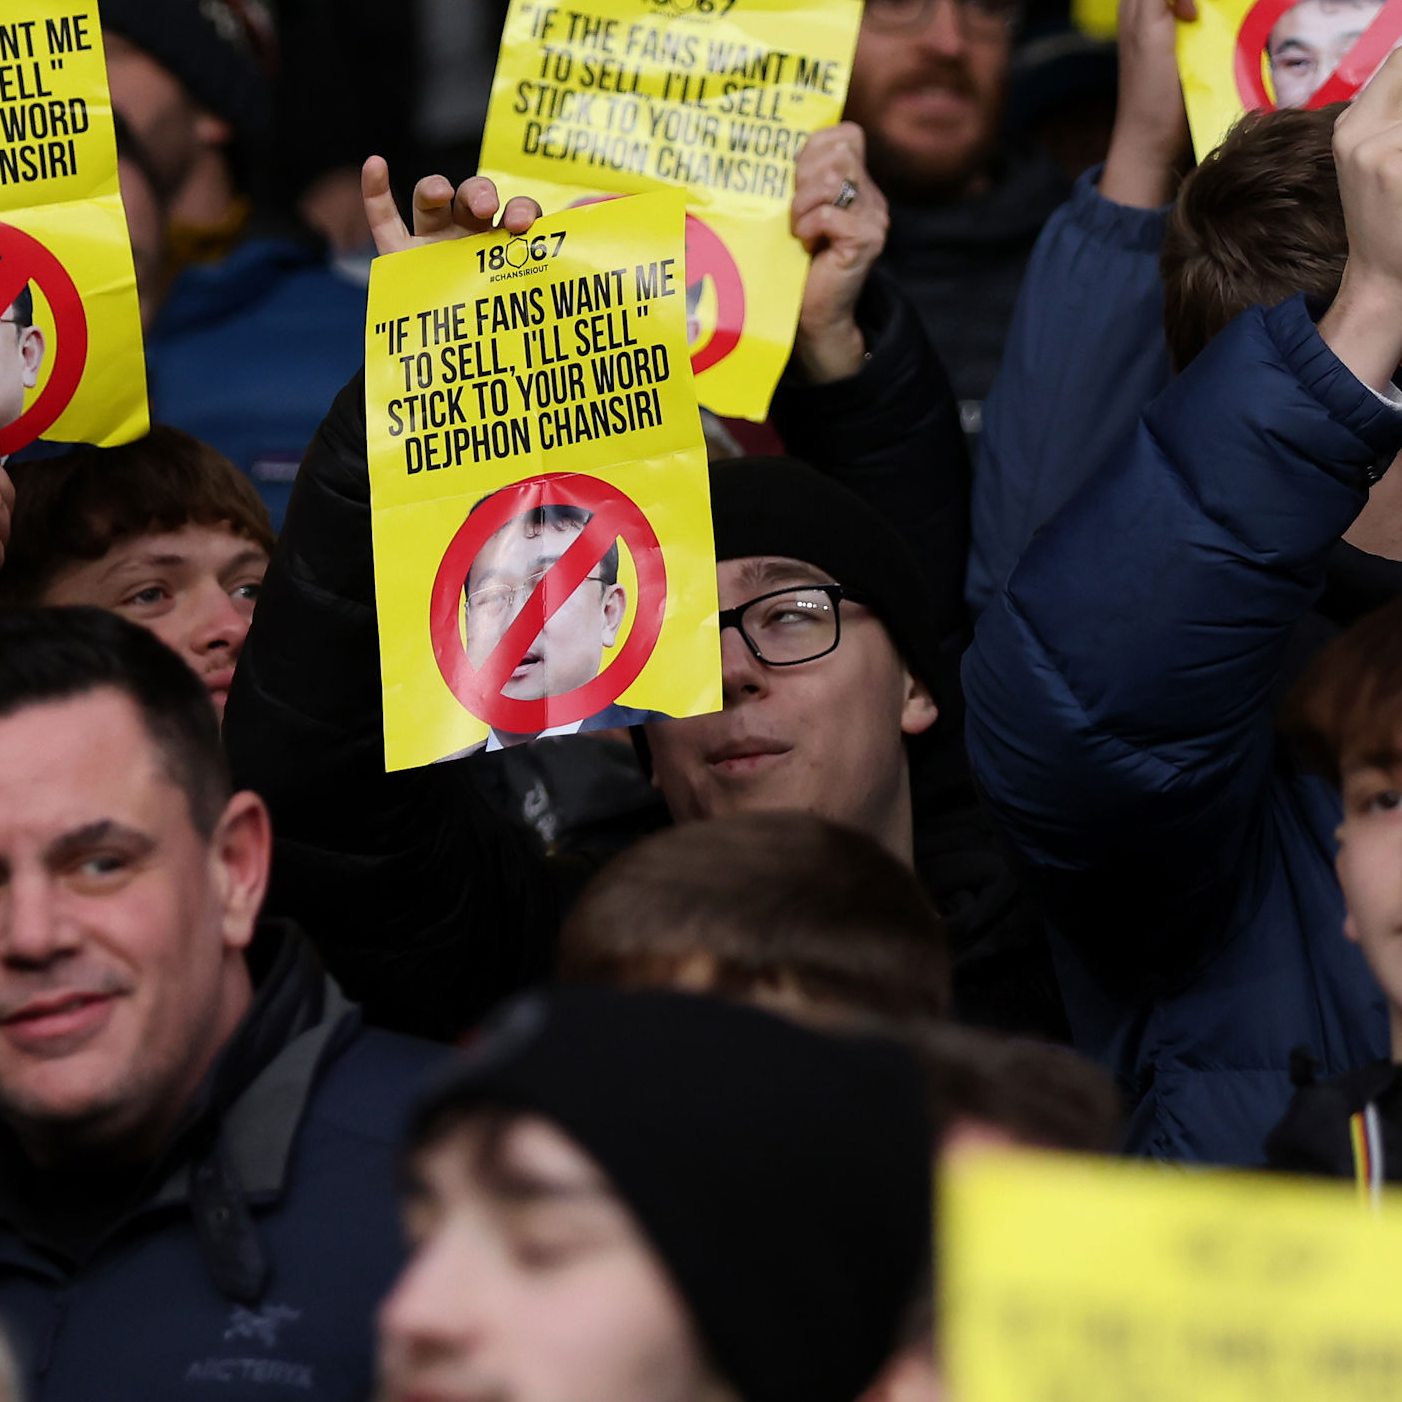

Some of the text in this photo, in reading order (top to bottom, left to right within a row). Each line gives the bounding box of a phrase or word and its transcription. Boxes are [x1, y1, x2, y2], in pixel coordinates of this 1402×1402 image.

[46, 14, 92, 55] ME
[567, 11, 619, 54] THE
[627, 23, 699, 68] FANS
[708, 41, 789, 85] WANT
[798, 56, 840, 96] ME
[539, 45, 573, 83] TO
[579, 60, 651, 103] SELL,
[662, 71, 709, 110] I'LL
[0, 97, 89, 143] WORD
[514, 80, 592, 126] STICK
[606, 95, 638, 135] TO
[648, 106, 719, 149] YOUR
[523, 122, 788, 199] DEJPHON CHANSIRI
[417, 303, 465, 347] THE
[476, 287, 545, 336] FANS
[551, 269, 627, 319] WANT
[635, 259, 675, 301] ME
[489, 264, 548, 282] #CHANSIRIOUT
[388, 344, 670, 436] STICK TO YOUR WORD
[400, 352, 432, 392] TO
[441, 338, 516, 384] SELL,
[523, 327, 569, 368] I'LL
[406, 388, 662, 475] DEJPHON CHANSIRI
